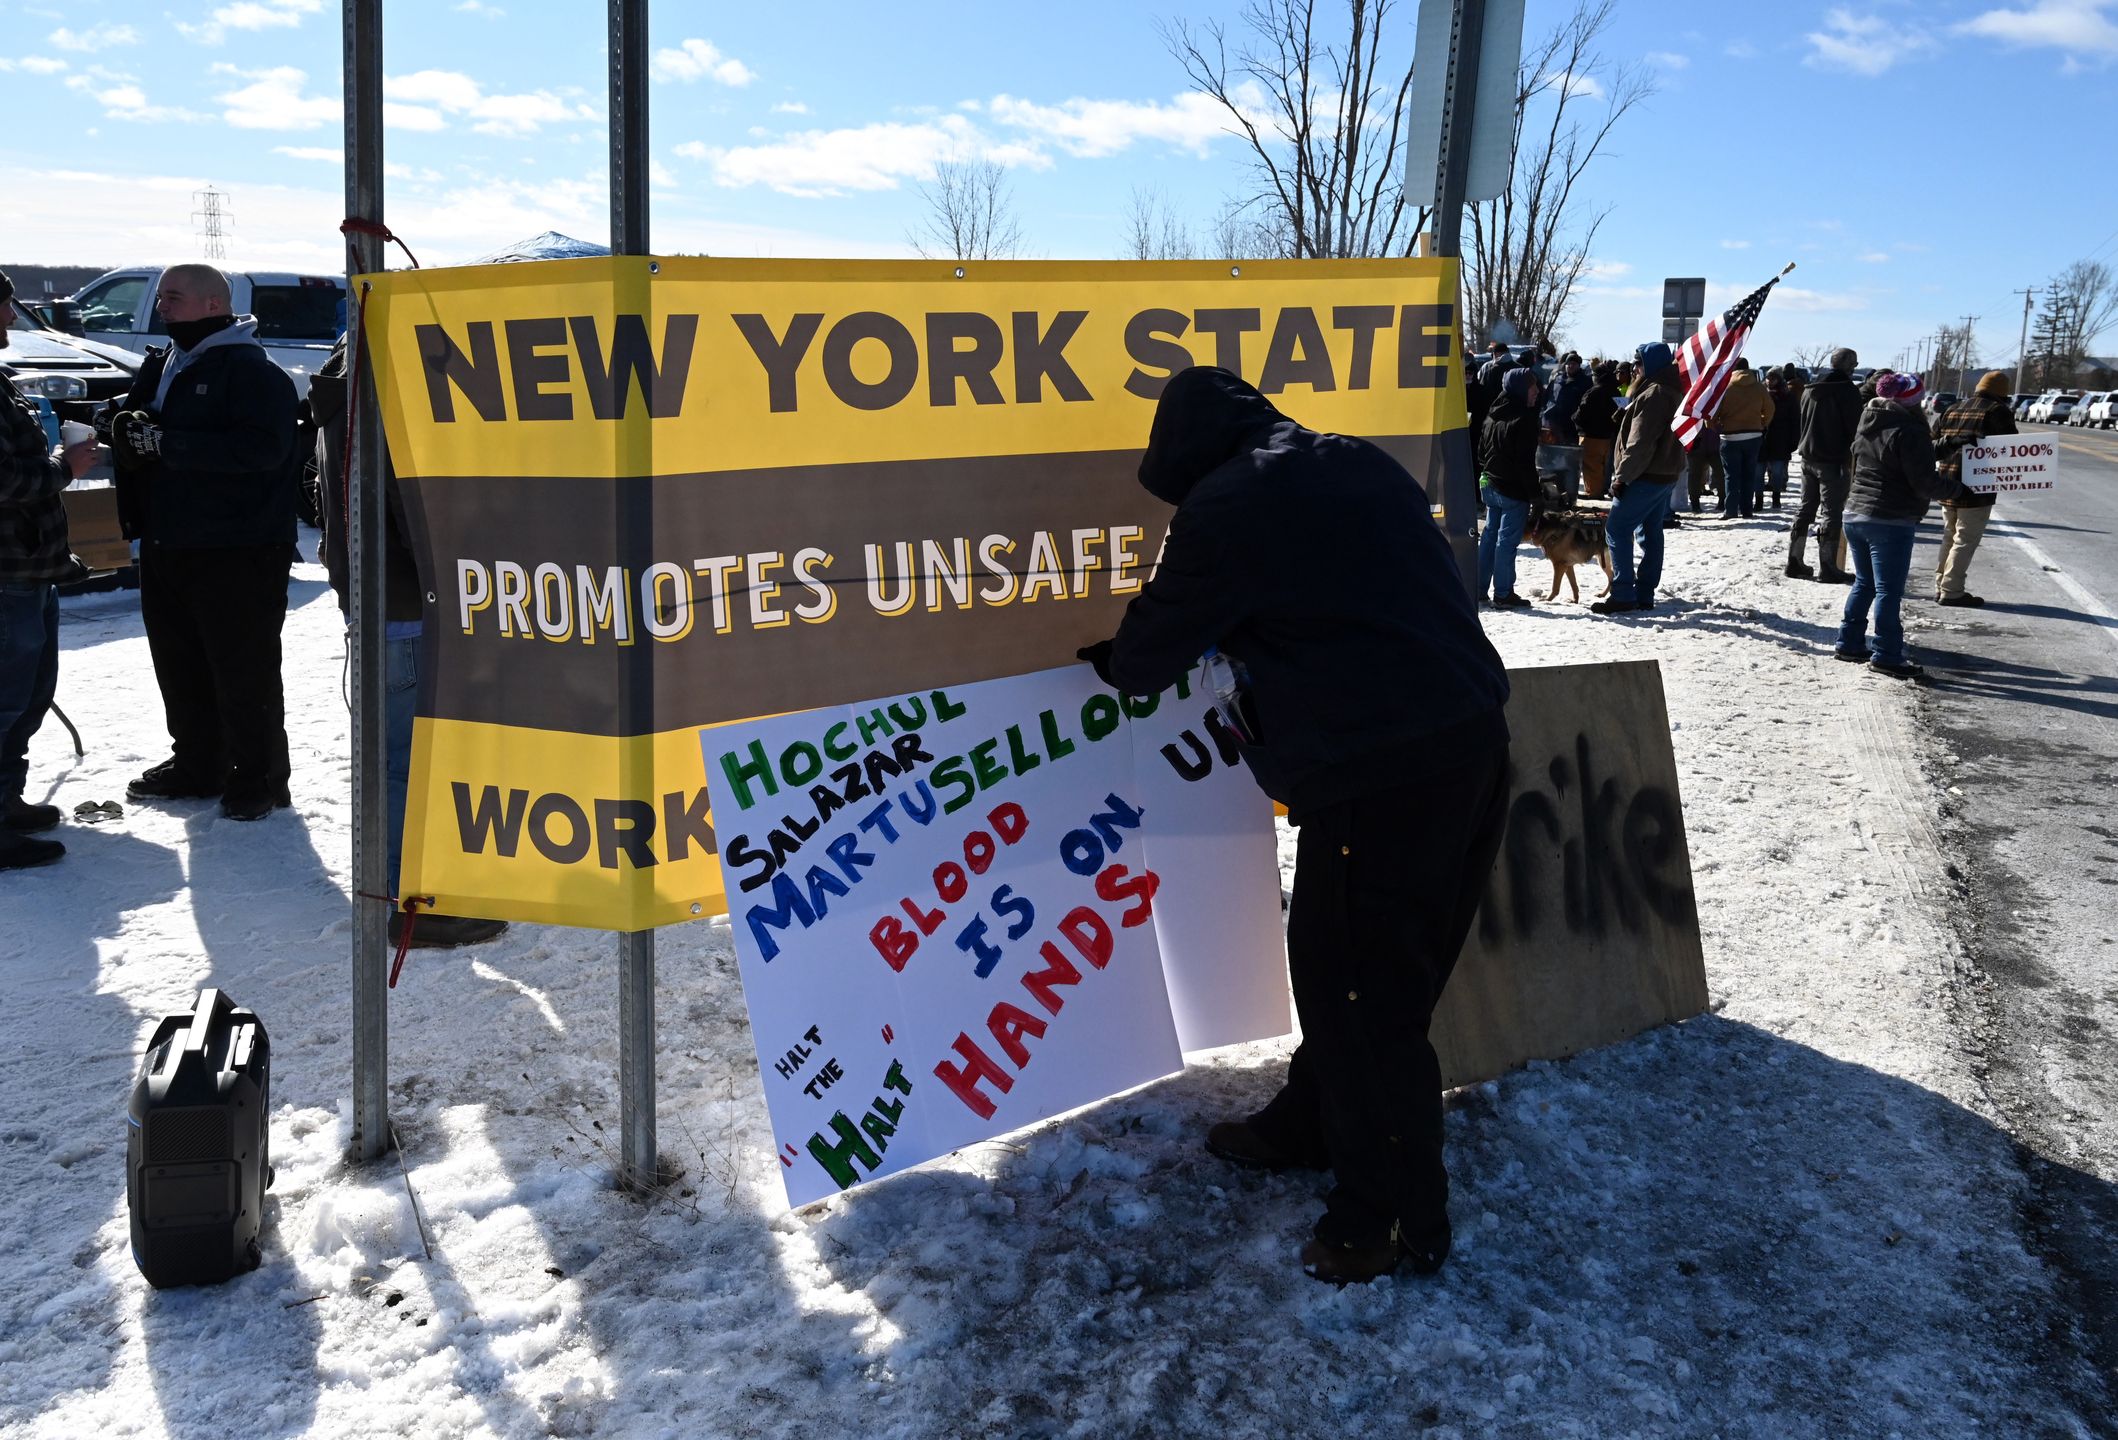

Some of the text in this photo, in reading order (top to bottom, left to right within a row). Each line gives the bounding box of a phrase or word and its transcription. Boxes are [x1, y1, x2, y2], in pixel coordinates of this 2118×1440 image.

[414, 303, 1455, 423] NEW YORK STATE
[1966, 447, 1998, 460] 70%
[2009, 443, 2053, 458] 100%
[1969, 482, 2053, 492] XPENDABLE
[1973, 465, 2046, 475] ESSENTIAL
[457, 545, 838, 647] PROMOTES
[864, 525, 1144, 618] UNSAFE
[719, 690, 967, 811] HOCHUL
[726, 733, 934, 892] SALAZAR
[869, 801, 1030, 973] BLOOD
[955, 884, 1036, 979] IS
[1059, 793, 1145, 876] ON
[933, 863, 1161, 1120] HANDS
[774, 1024, 822, 1081] HALT
[803, 1057, 844, 1100] THE
